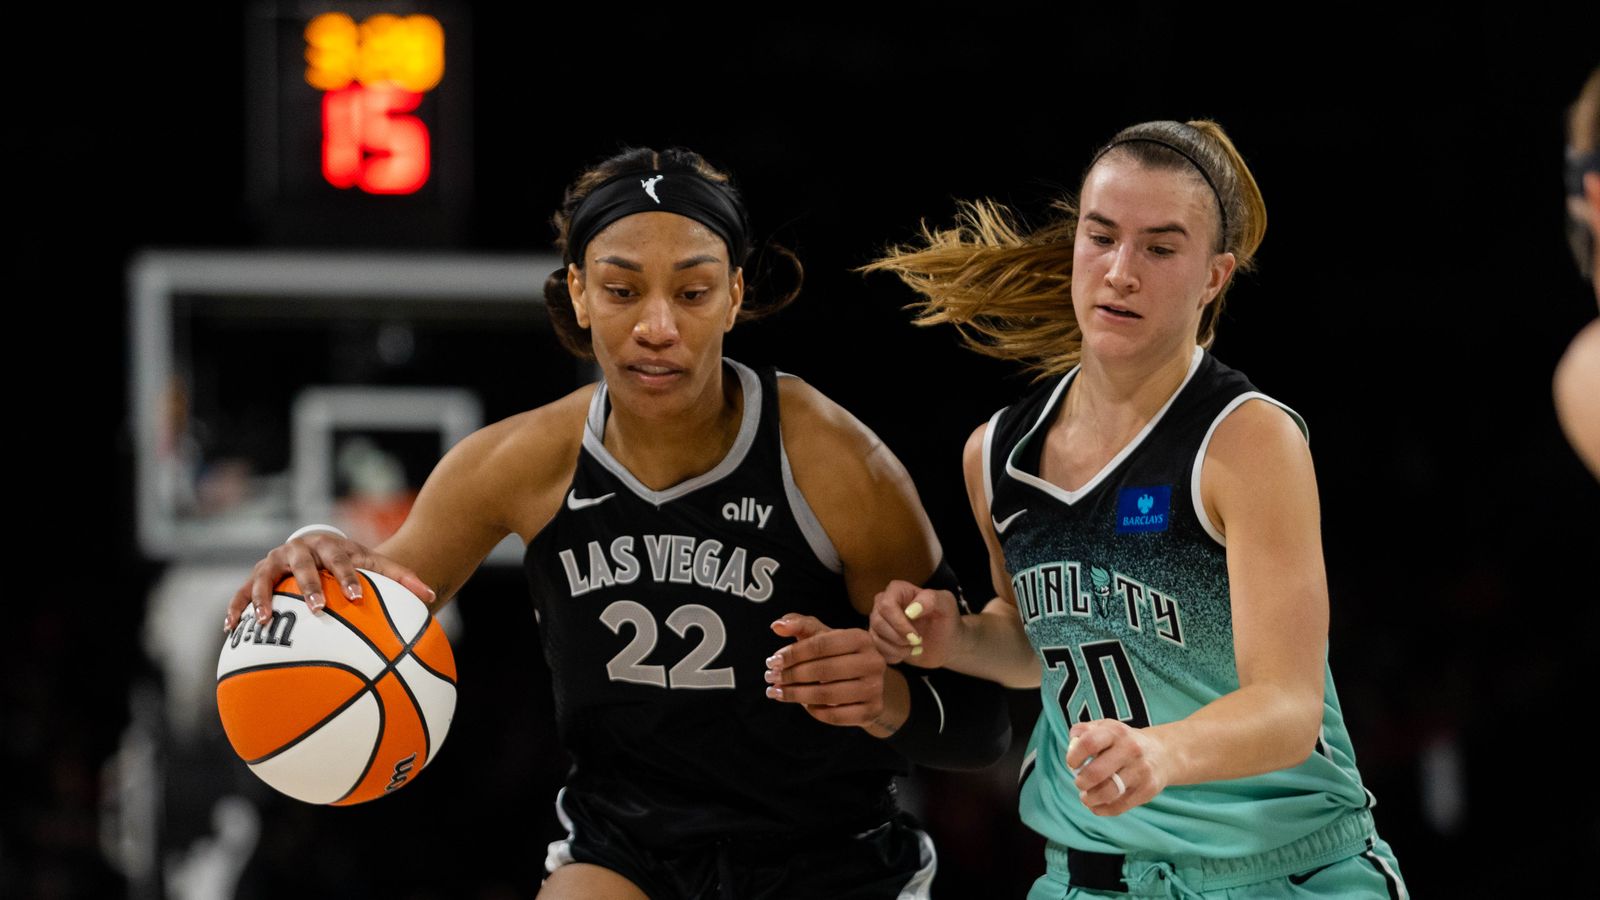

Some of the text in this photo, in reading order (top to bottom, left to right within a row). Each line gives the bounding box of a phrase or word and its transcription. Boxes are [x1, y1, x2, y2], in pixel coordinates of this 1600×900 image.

[321, 84, 431, 195] 15
[721, 497, 773, 529] ally
[1122, 514, 1164, 527] BARCLAYS
[558, 534, 781, 603] LAS VEGAS
[599, 600, 736, 689] 22
[1041, 639, 1152, 731] 20
